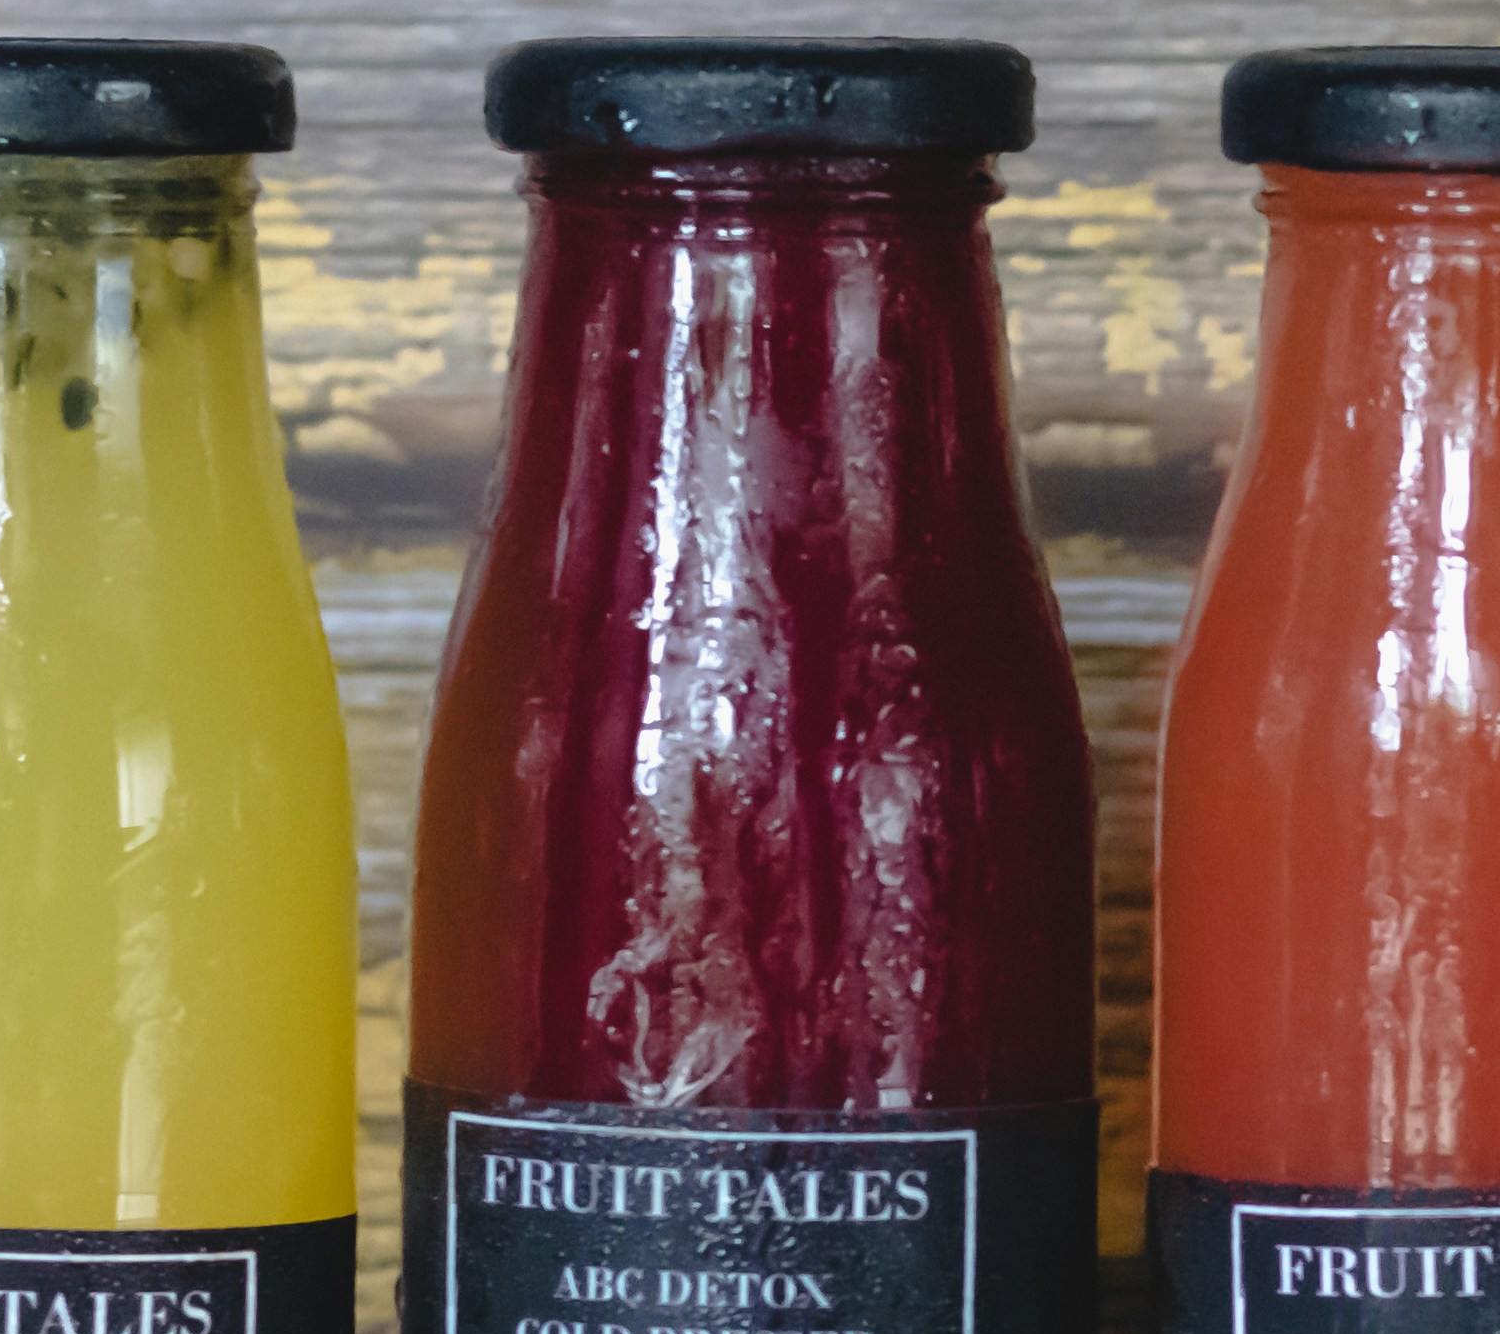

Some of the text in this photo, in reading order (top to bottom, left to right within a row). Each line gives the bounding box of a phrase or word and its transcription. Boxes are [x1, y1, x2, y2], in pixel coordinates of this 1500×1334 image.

[482, 1153, 929, 1223] FRUIT TALES
[554, 1265, 833, 1309] ABC DETOX
[1276, 1243, 1495, 1298] FRUIT
